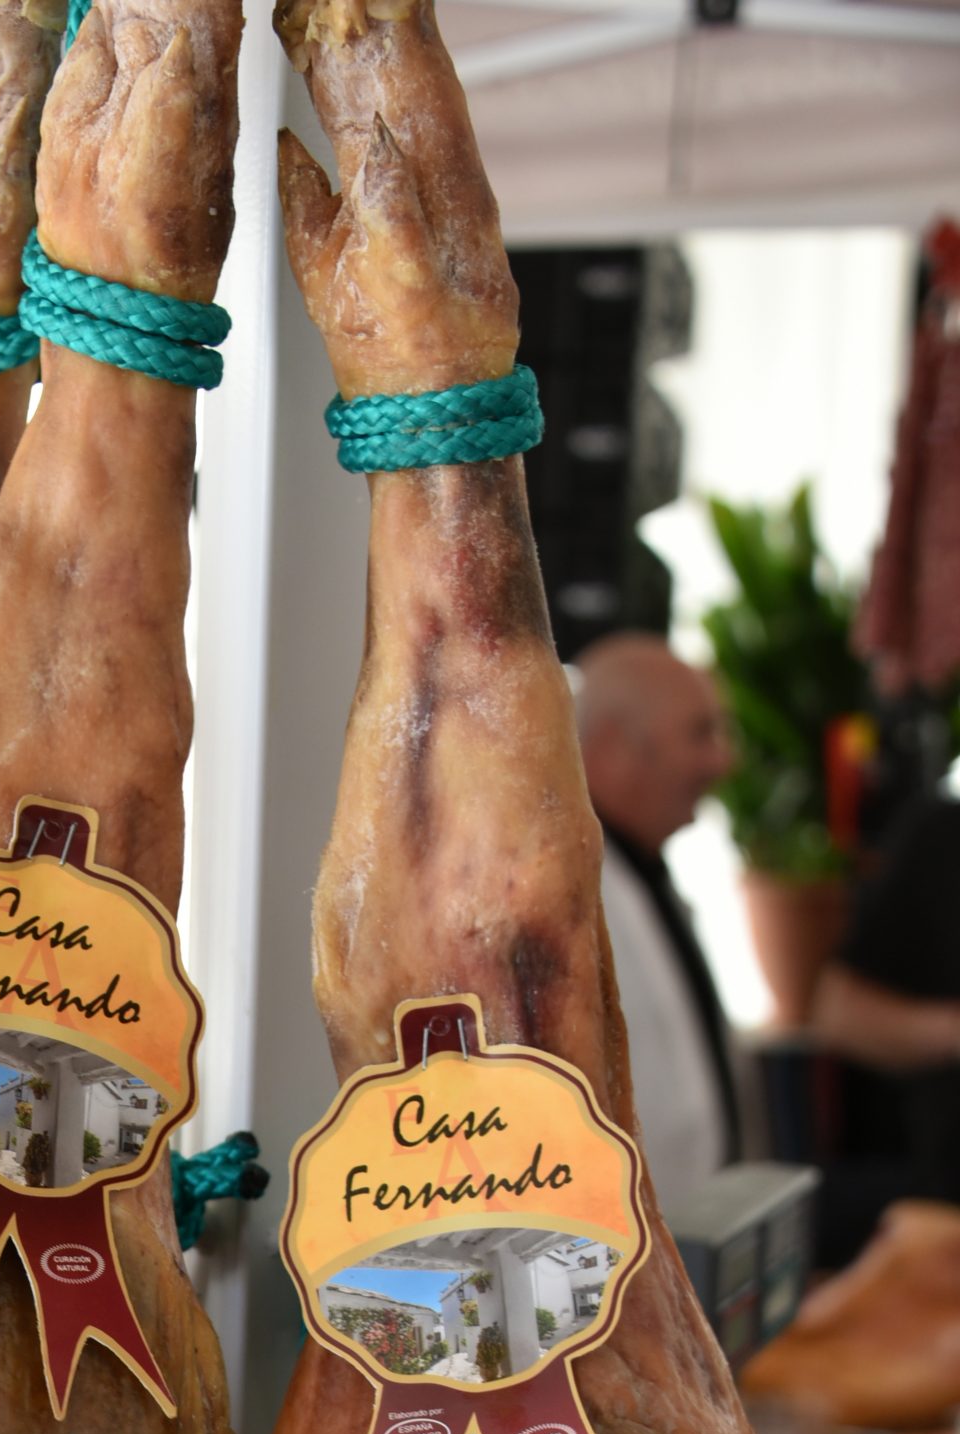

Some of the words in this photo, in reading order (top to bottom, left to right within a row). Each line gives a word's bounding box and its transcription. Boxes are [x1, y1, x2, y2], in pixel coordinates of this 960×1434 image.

[393, 1095, 507, 1147] Casa
[342, 1143, 573, 1222] Fernando
[56, 1264, 90, 1272] NATURAL
[398, 1422, 434, 1434] ESPAÑA
